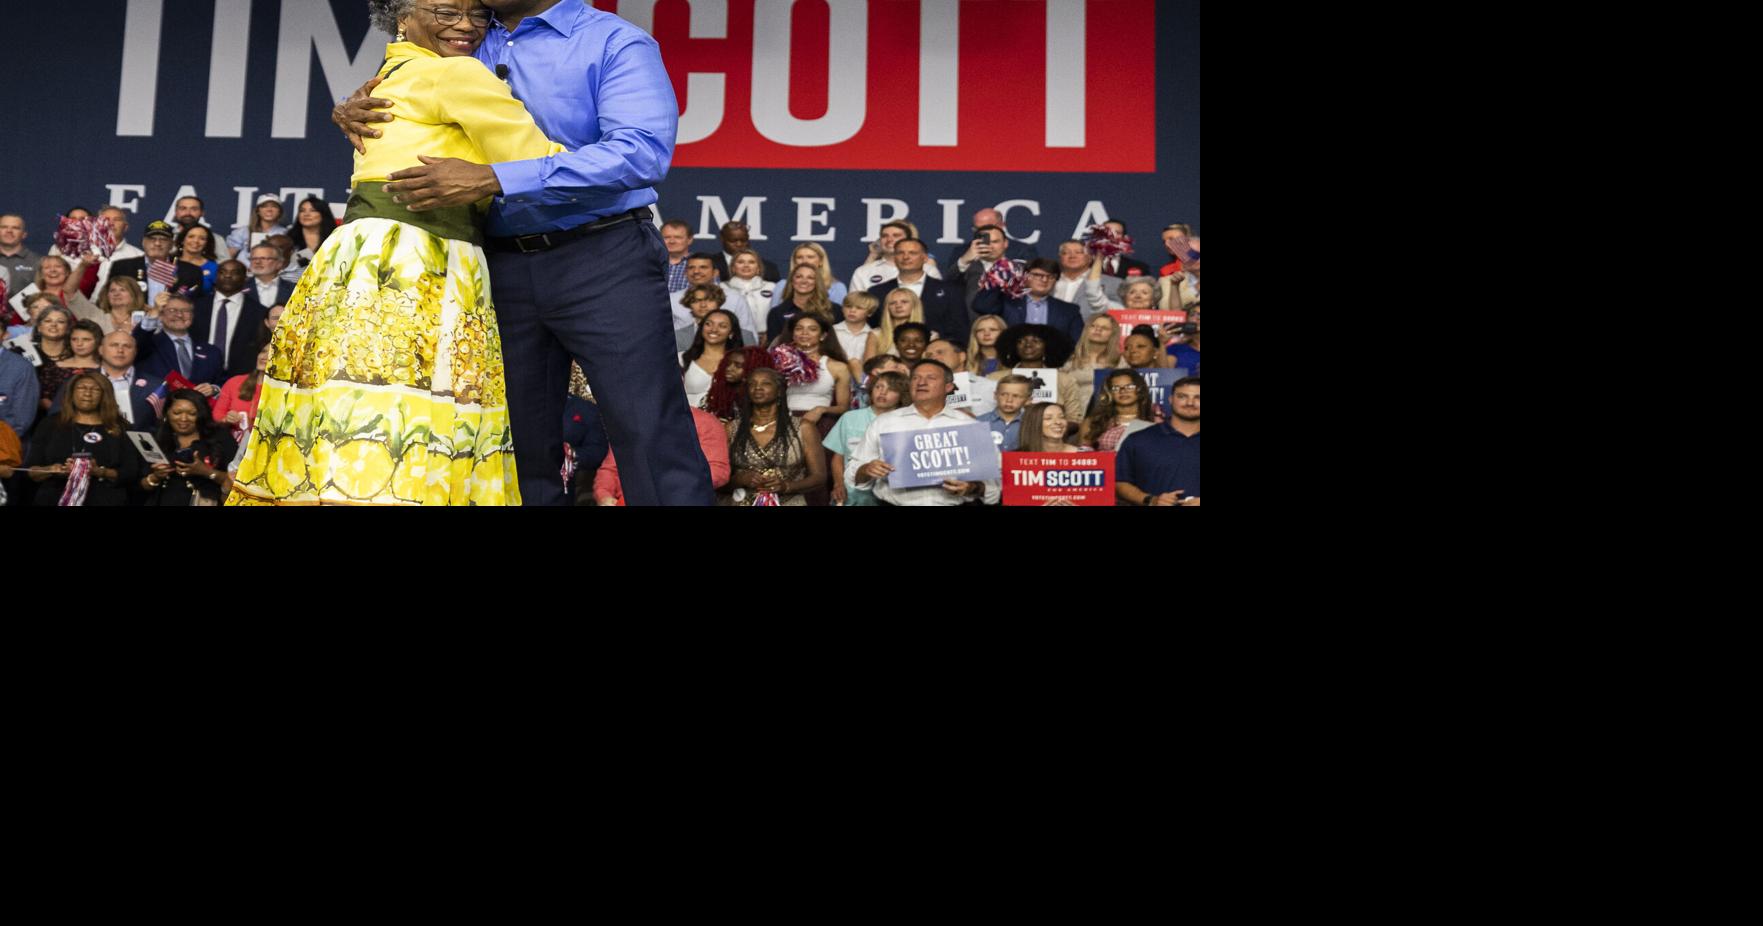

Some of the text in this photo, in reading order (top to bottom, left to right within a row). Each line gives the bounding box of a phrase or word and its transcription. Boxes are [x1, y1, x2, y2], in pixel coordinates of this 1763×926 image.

[105, 184, 352, 229] FAIT
[914, 431, 958, 450] GREAT
[910, 447, 971, 470] SCOTT!
[1011, 470, 1103, 486] TIM SCOTT
